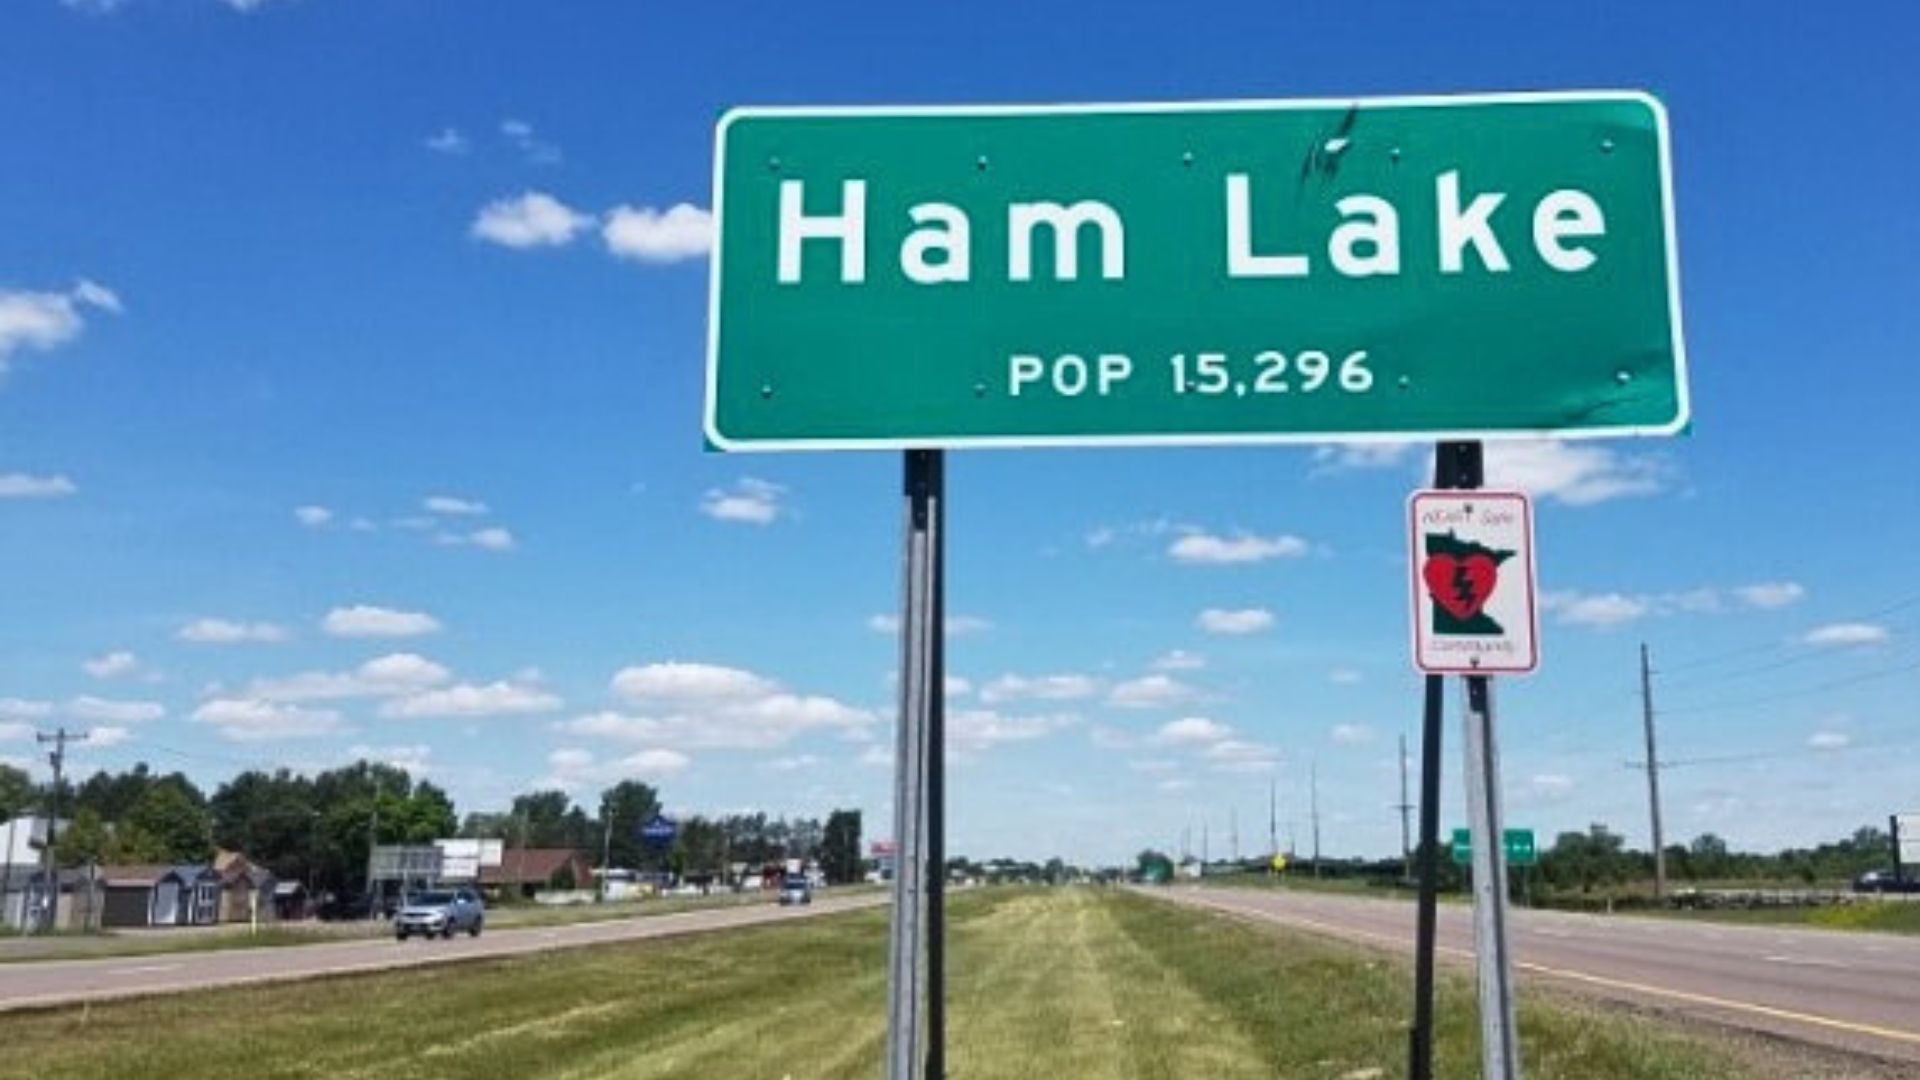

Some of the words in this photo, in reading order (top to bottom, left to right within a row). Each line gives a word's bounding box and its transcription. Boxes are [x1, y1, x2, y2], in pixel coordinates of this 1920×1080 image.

[777, 179, 1126, 283] Ham
[1226, 170, 1606, 277] Lake
[1009, 354, 1133, 396] POP
[1170, 350, 1374, 397] 15,296
